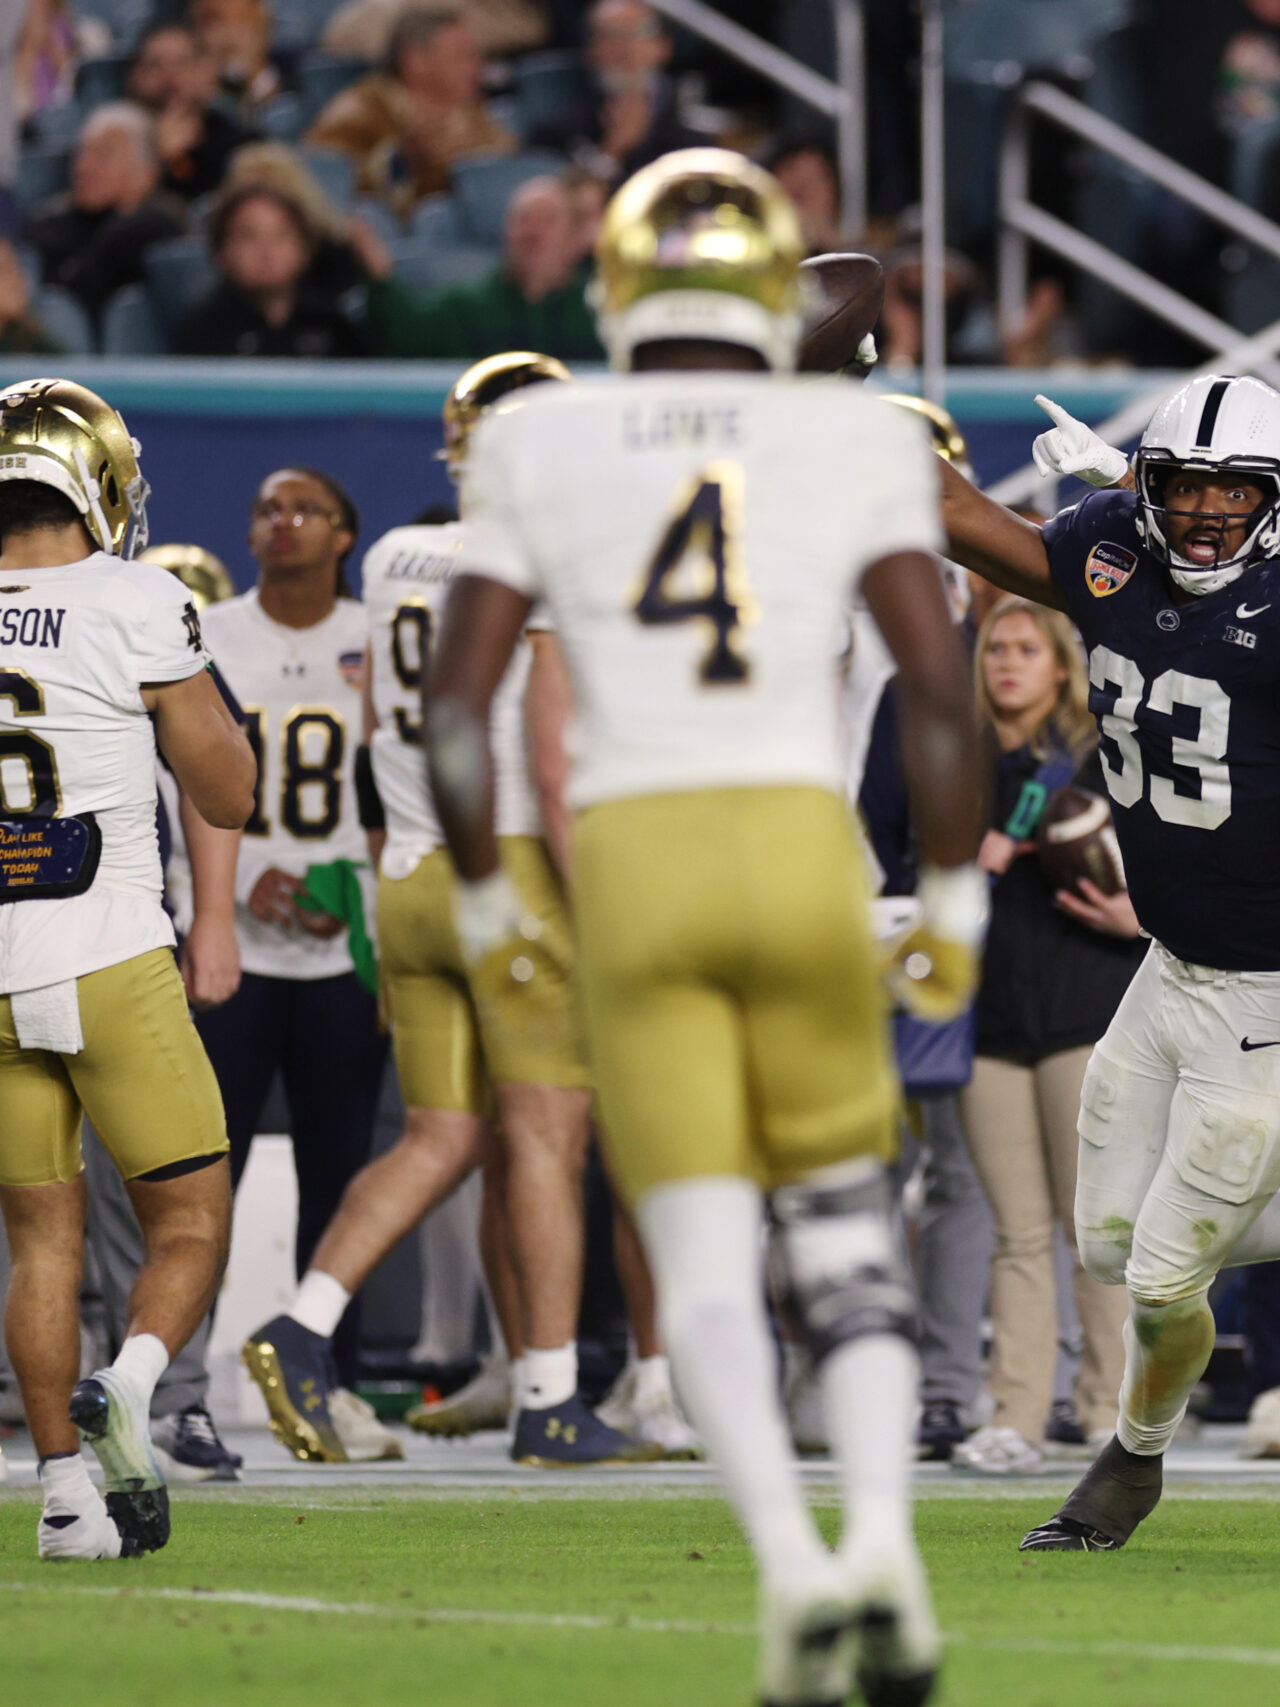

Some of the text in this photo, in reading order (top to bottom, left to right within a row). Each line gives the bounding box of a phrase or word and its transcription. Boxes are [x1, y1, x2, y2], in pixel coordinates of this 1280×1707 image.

[622, 460, 760, 688] 4
[1088, 643, 1232, 831] 33
[2, 863, 39, 875] TODAY
[21, 831, 44, 843] LIKE
